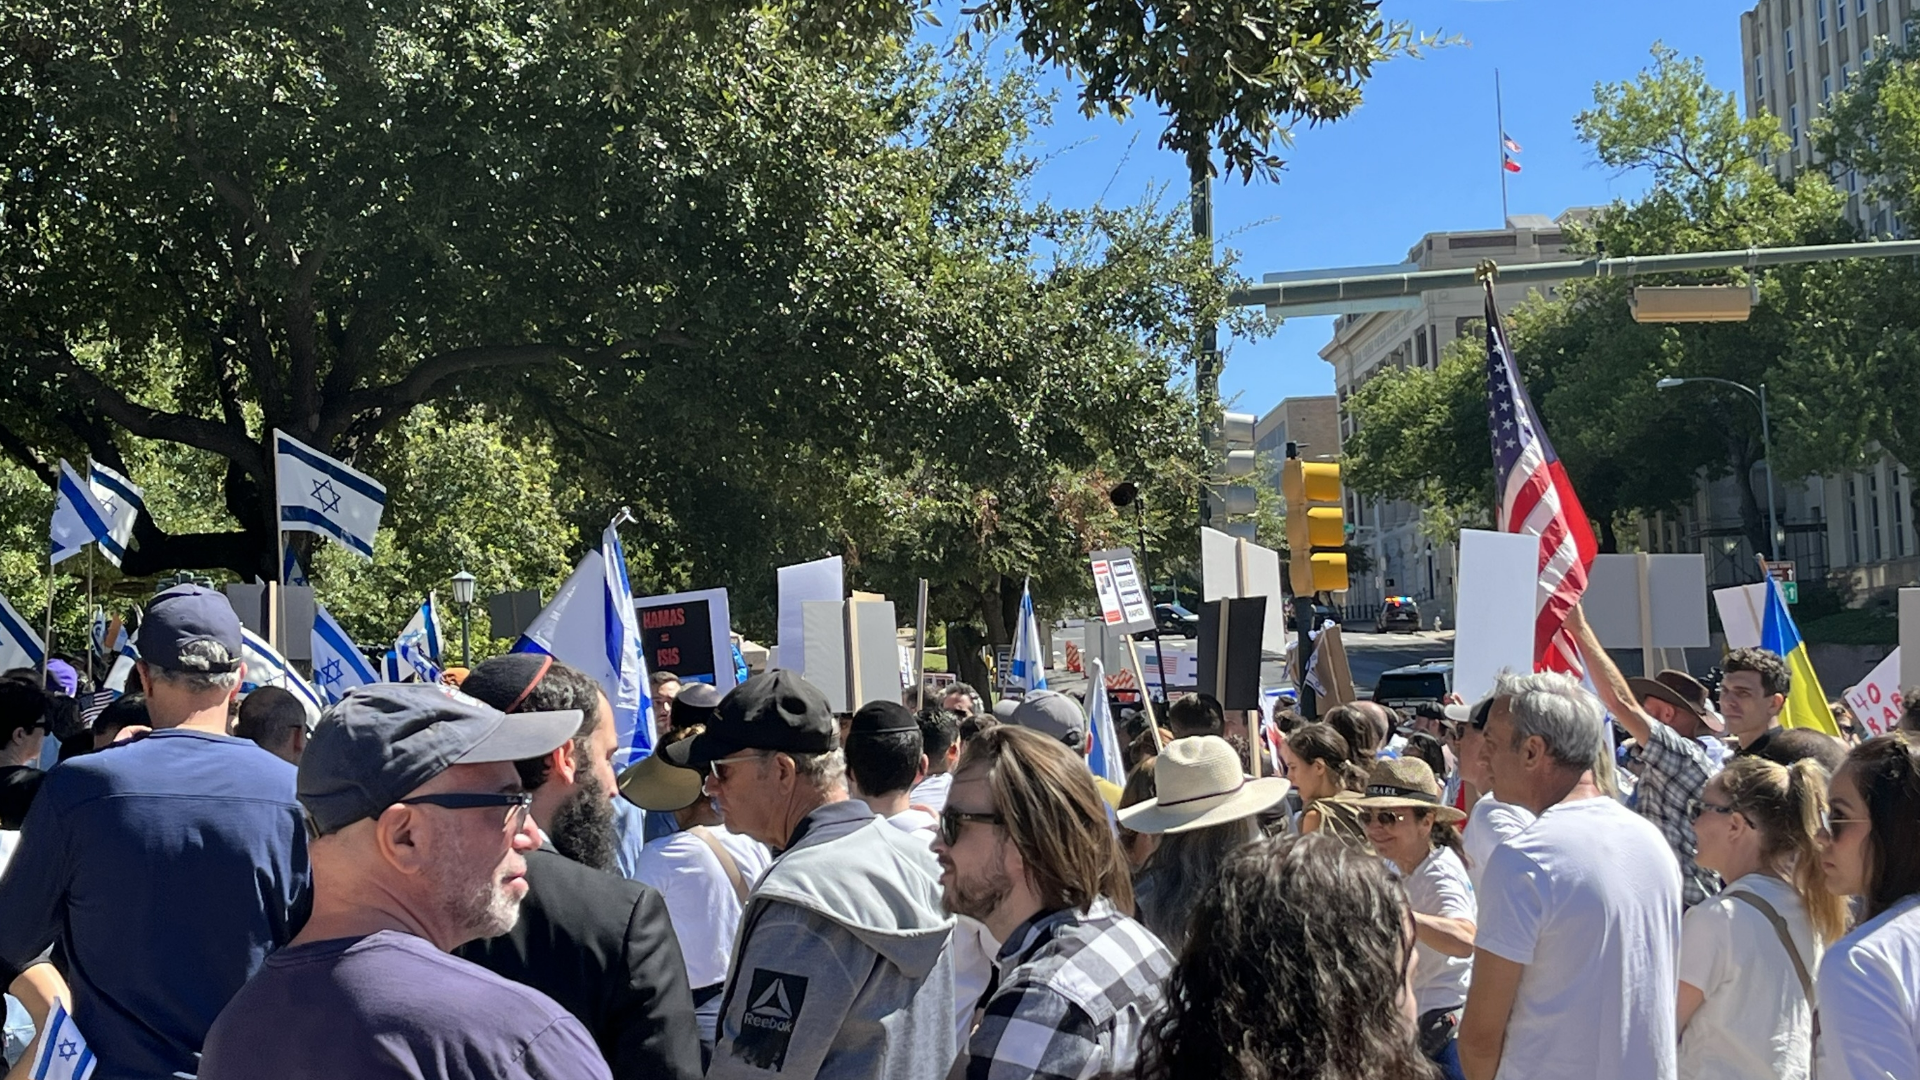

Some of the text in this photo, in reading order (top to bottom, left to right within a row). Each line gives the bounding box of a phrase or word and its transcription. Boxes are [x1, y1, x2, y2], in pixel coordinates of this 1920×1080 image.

[643, 607, 685, 629] HAMAS
[657, 647, 680, 667] ISIS
[1851, 682, 1882, 711] 40
[744, 1012, 793, 1032] Reebok
